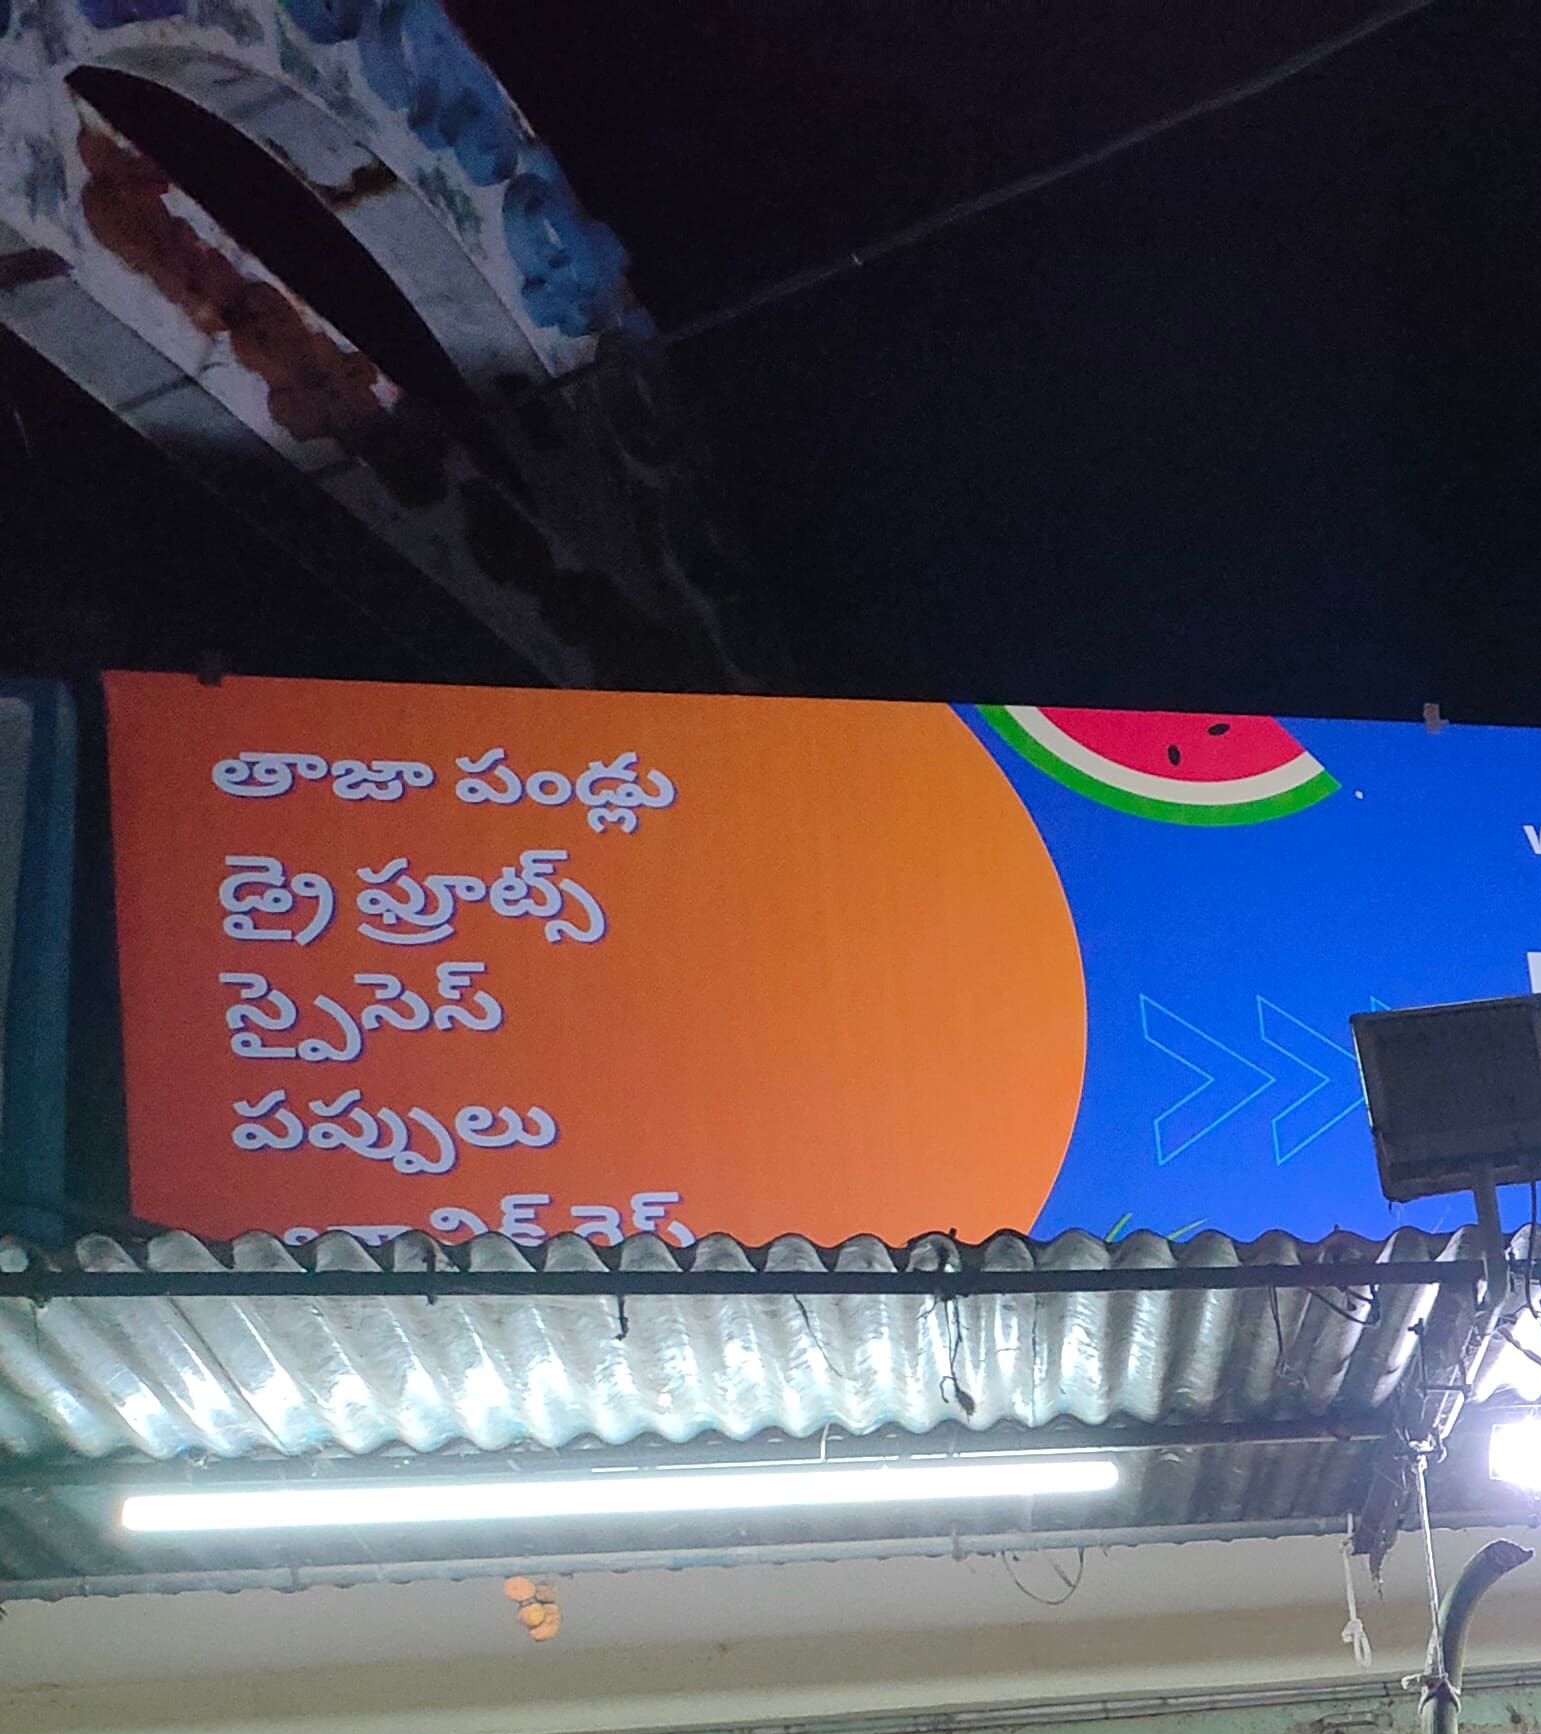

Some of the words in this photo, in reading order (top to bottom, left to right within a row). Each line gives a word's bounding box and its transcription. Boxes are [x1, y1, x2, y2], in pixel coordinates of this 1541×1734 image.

[211, 749, 434, 798] తాజా
[454, 747, 677, 833] పండ్లు
[218, 854, 336, 946] డ్రై
[356, 849, 608, 946] ఫ్రూట్స్
[219, 961, 504, 1063] స్పైసెస్
[231, 1088, 559, 1176] పప్పులు
